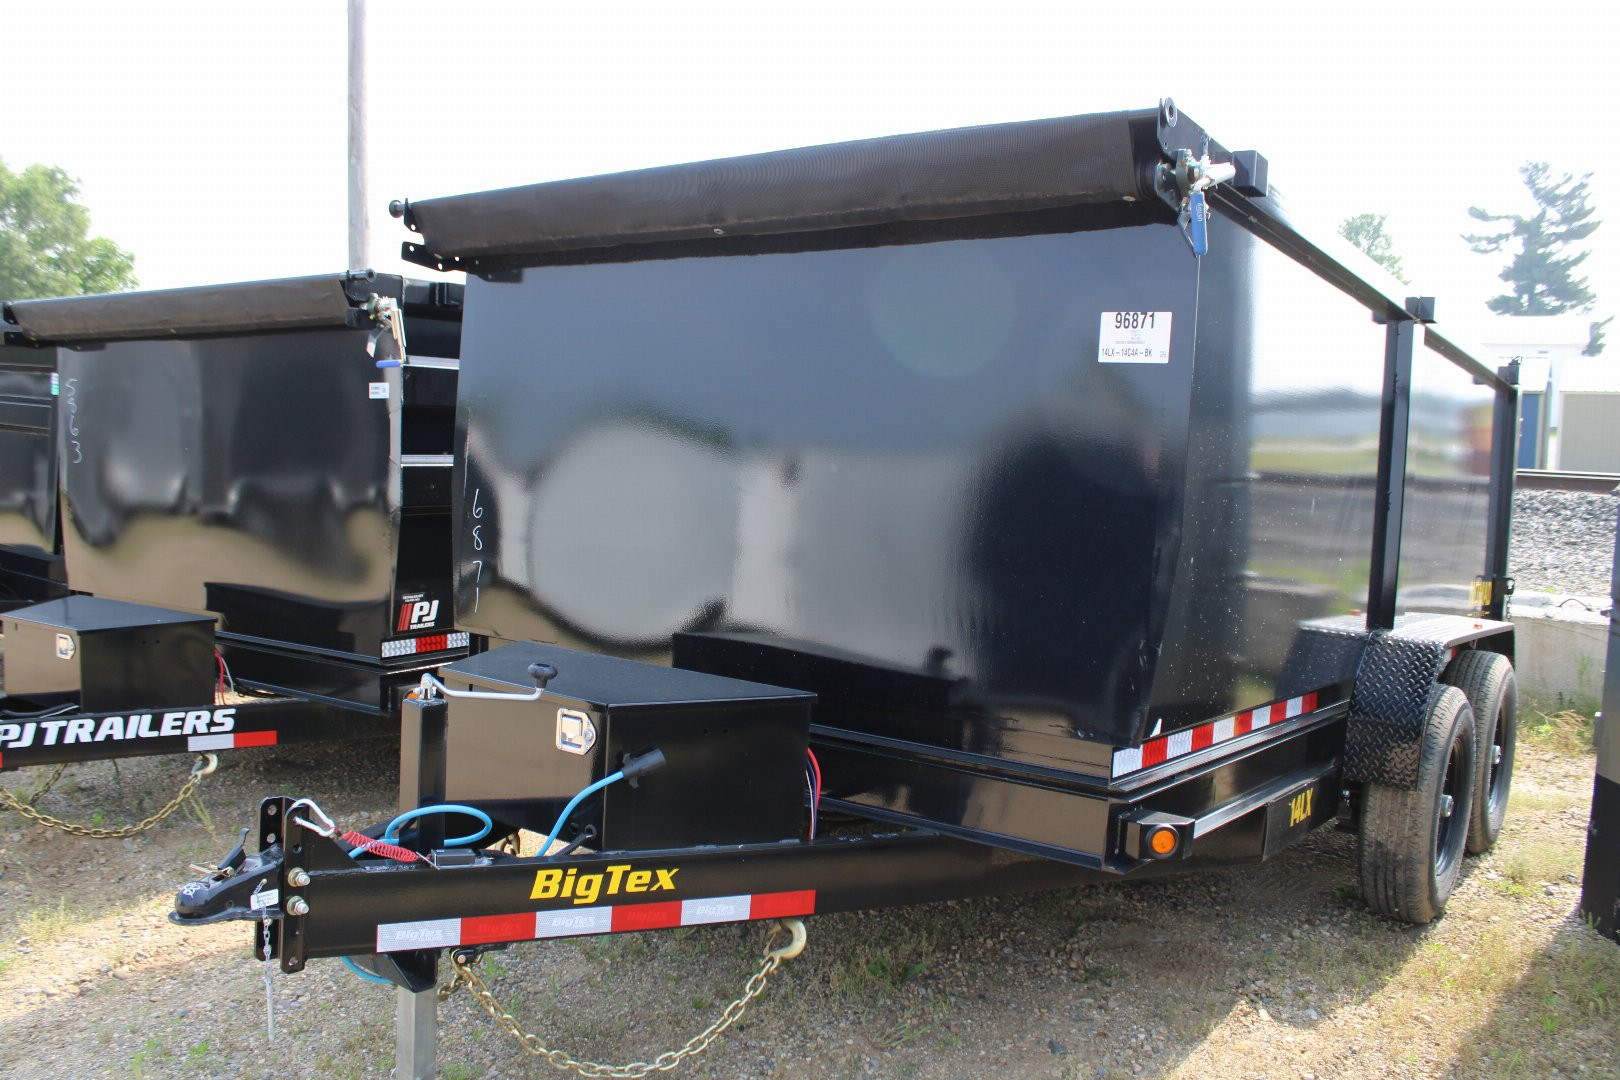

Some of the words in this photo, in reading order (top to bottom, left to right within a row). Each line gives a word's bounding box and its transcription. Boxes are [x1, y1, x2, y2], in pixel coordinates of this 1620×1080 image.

[1115, 312, 1155, 329] 96871
[411, 599, 440, 624] PJ
[0, 722, 37, 748] PJ
[40, 708, 237, 746] TRAILERS
[529, 864, 680, 905] BigTex
